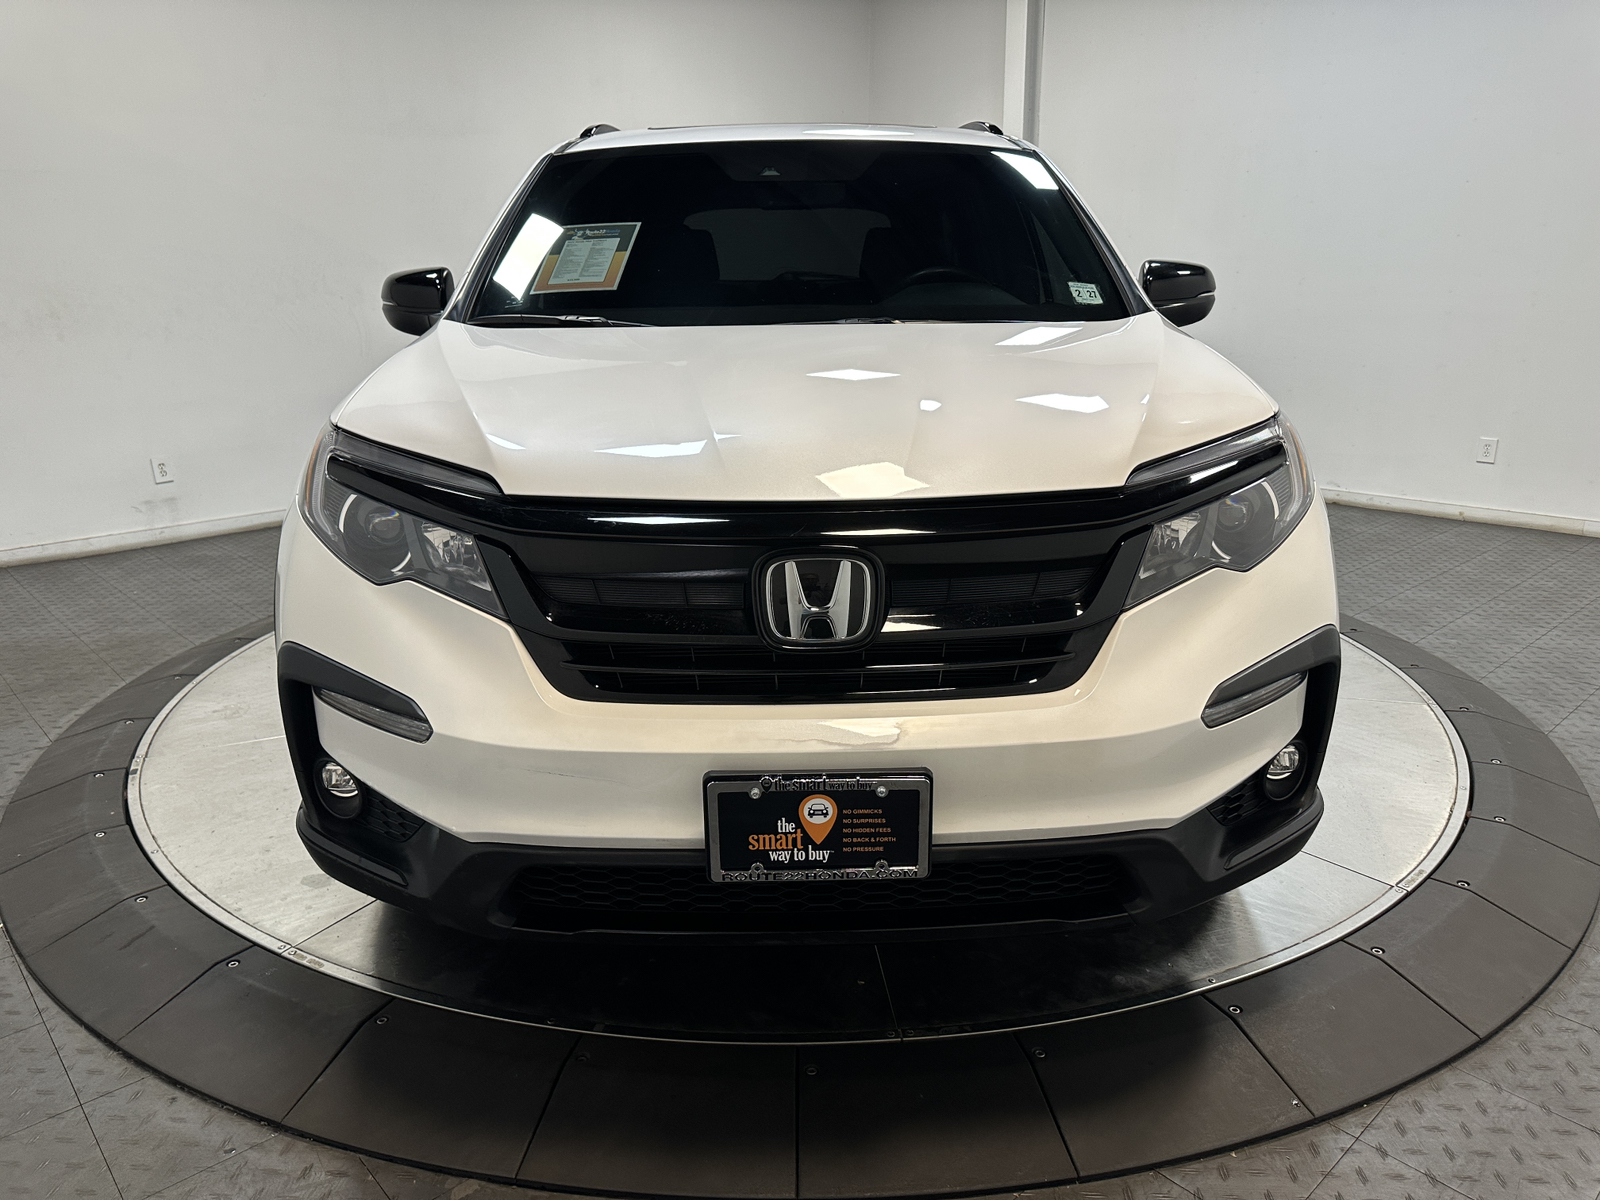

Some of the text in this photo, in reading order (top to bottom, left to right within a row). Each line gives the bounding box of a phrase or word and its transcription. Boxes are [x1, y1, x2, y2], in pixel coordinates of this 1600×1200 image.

[1075, 289, 1097, 299] 2 27
[774, 776, 873, 791] the smart way to buy
[777, 817, 796, 833] the
[748, 828, 804, 850] smart
[768, 850, 791, 864] way
[793, 848, 806, 861] to
[721, 869, 918, 882] ROUTE22HONDA.COM
